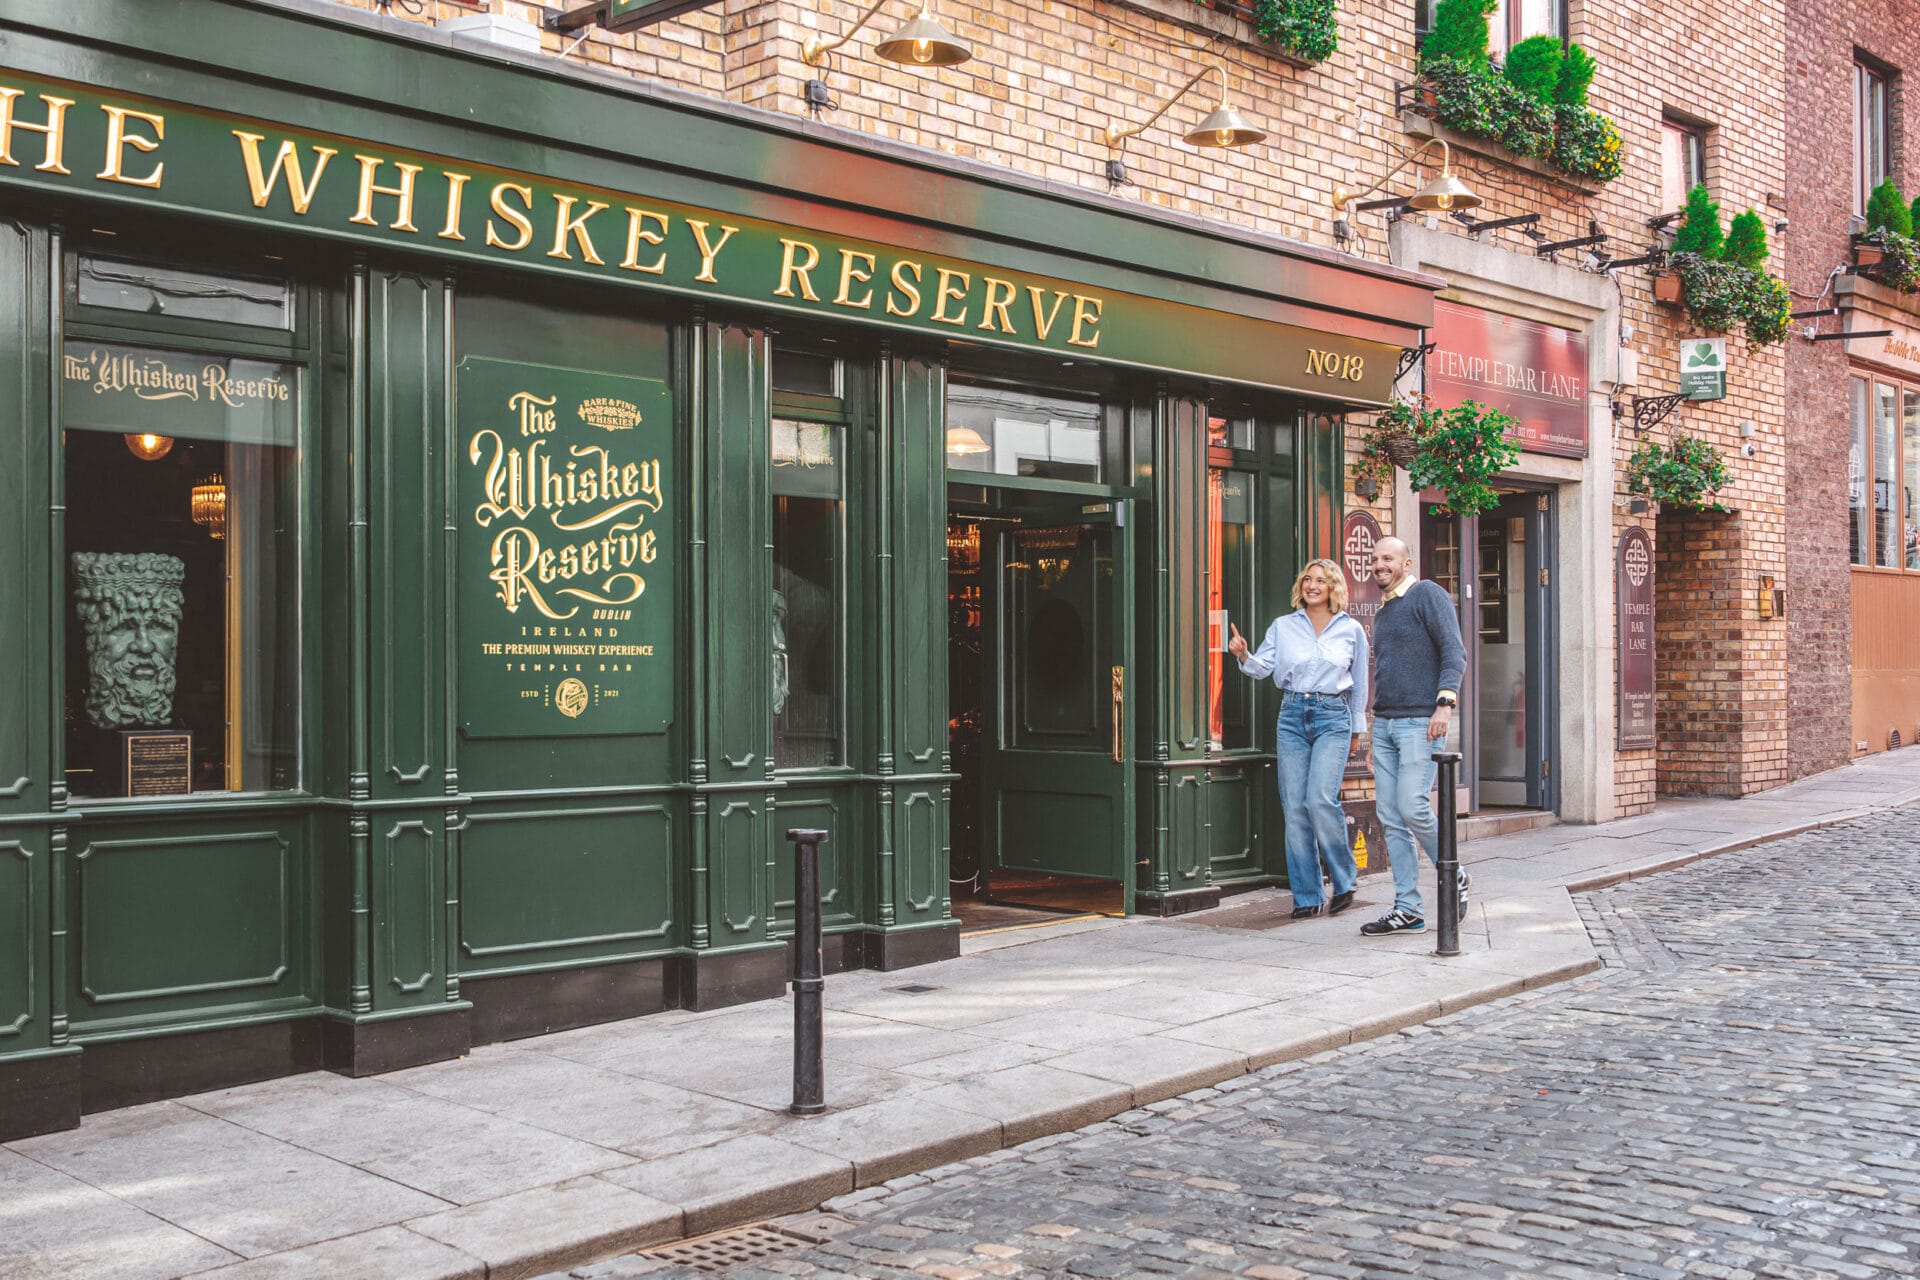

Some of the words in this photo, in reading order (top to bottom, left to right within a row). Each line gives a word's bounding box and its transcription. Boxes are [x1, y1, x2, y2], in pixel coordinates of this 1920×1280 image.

[231, 129, 740, 284] WHISKEY
[773, 238, 1103, 349] RESERVE
[90, 349, 199, 401] Whiskey
[202, 364, 289, 408] Reserve
[1436, 349, 1503, 385] TEMPLE
[1505, 363, 1537, 392] BAR
[1540, 371, 1581, 400] LANE
[583, 397, 607, 408] RARE
[508, 391, 557, 437] The
[586, 414, 634, 427] WHISKIES
[469, 430, 664, 531] Whiskey
[489, 514, 657, 620] Reserve
[592, 609, 632, 621] DUBLIN
[1624, 603, 1651, 615] TEMPLE
[521, 626, 618, 638] IRELAND
[1631, 621, 1645, 633] BAR
[482, 643, 503, 655] THE
[504, 643, 551, 656] PREMIUM
[553, 644, 596, 656] WHISKEY
[598, 645, 654, 657] EXPERIENCE
[1629, 638, 1647, 650] LANE
[506, 663, 582, 672] TEMPLE
[600, 663, 633, 672] BAR
